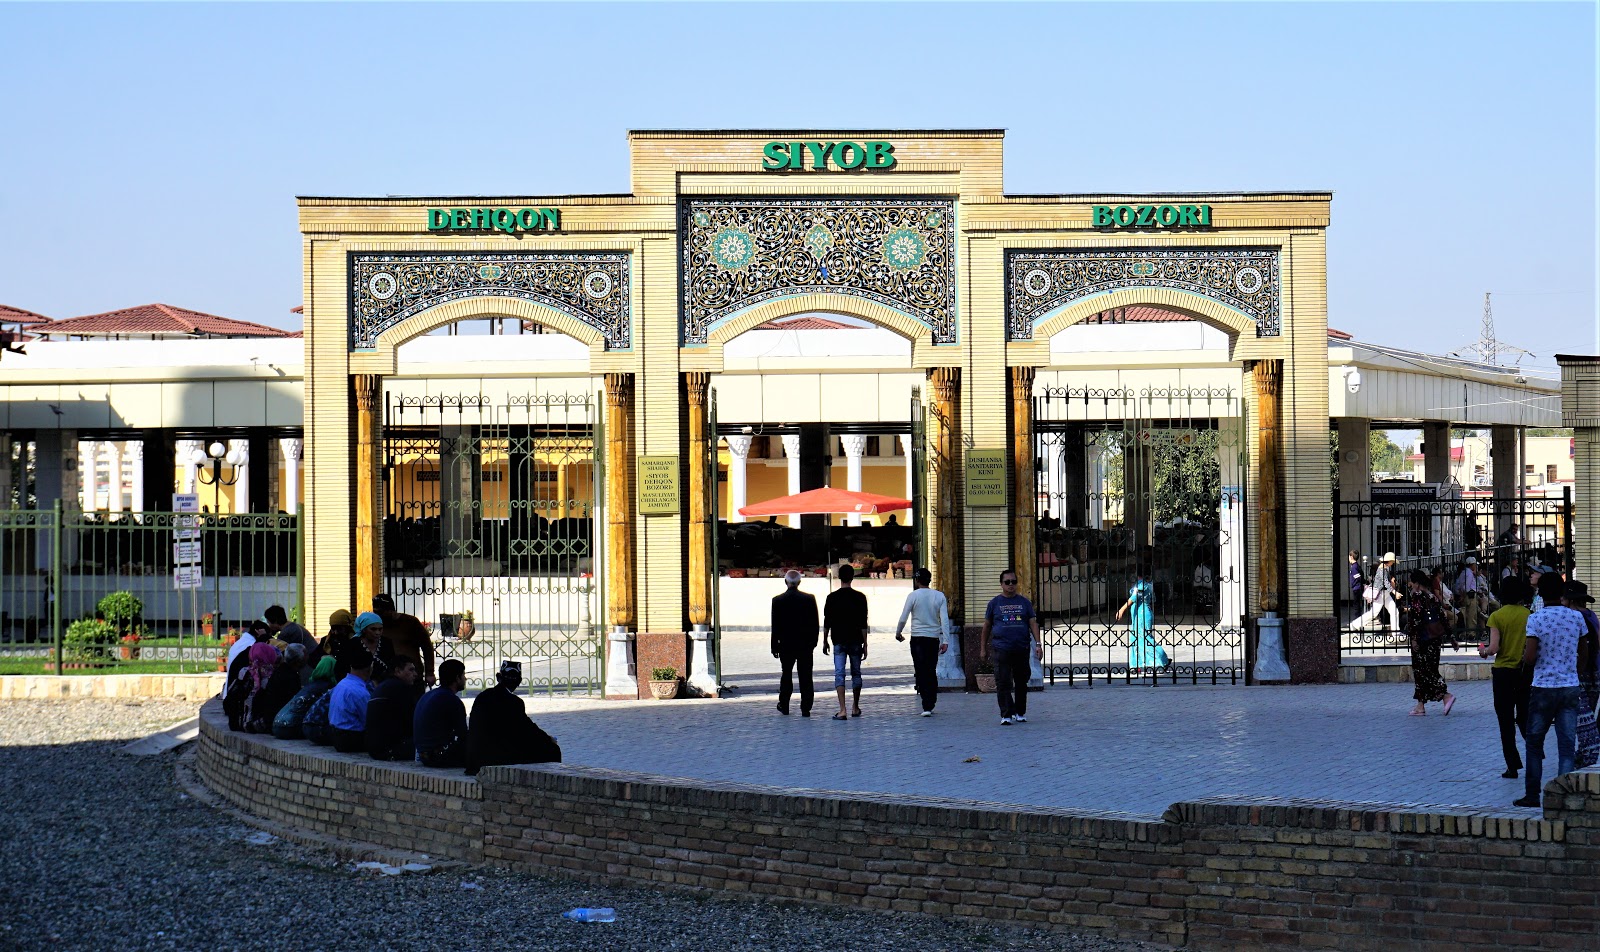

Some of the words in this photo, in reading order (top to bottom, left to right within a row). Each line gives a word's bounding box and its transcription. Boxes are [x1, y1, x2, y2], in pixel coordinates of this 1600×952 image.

[762, 140, 896, 170] SIYOB
[427, 207, 561, 233] DEHQON
[1091, 204, 1212, 227] BOZORI
